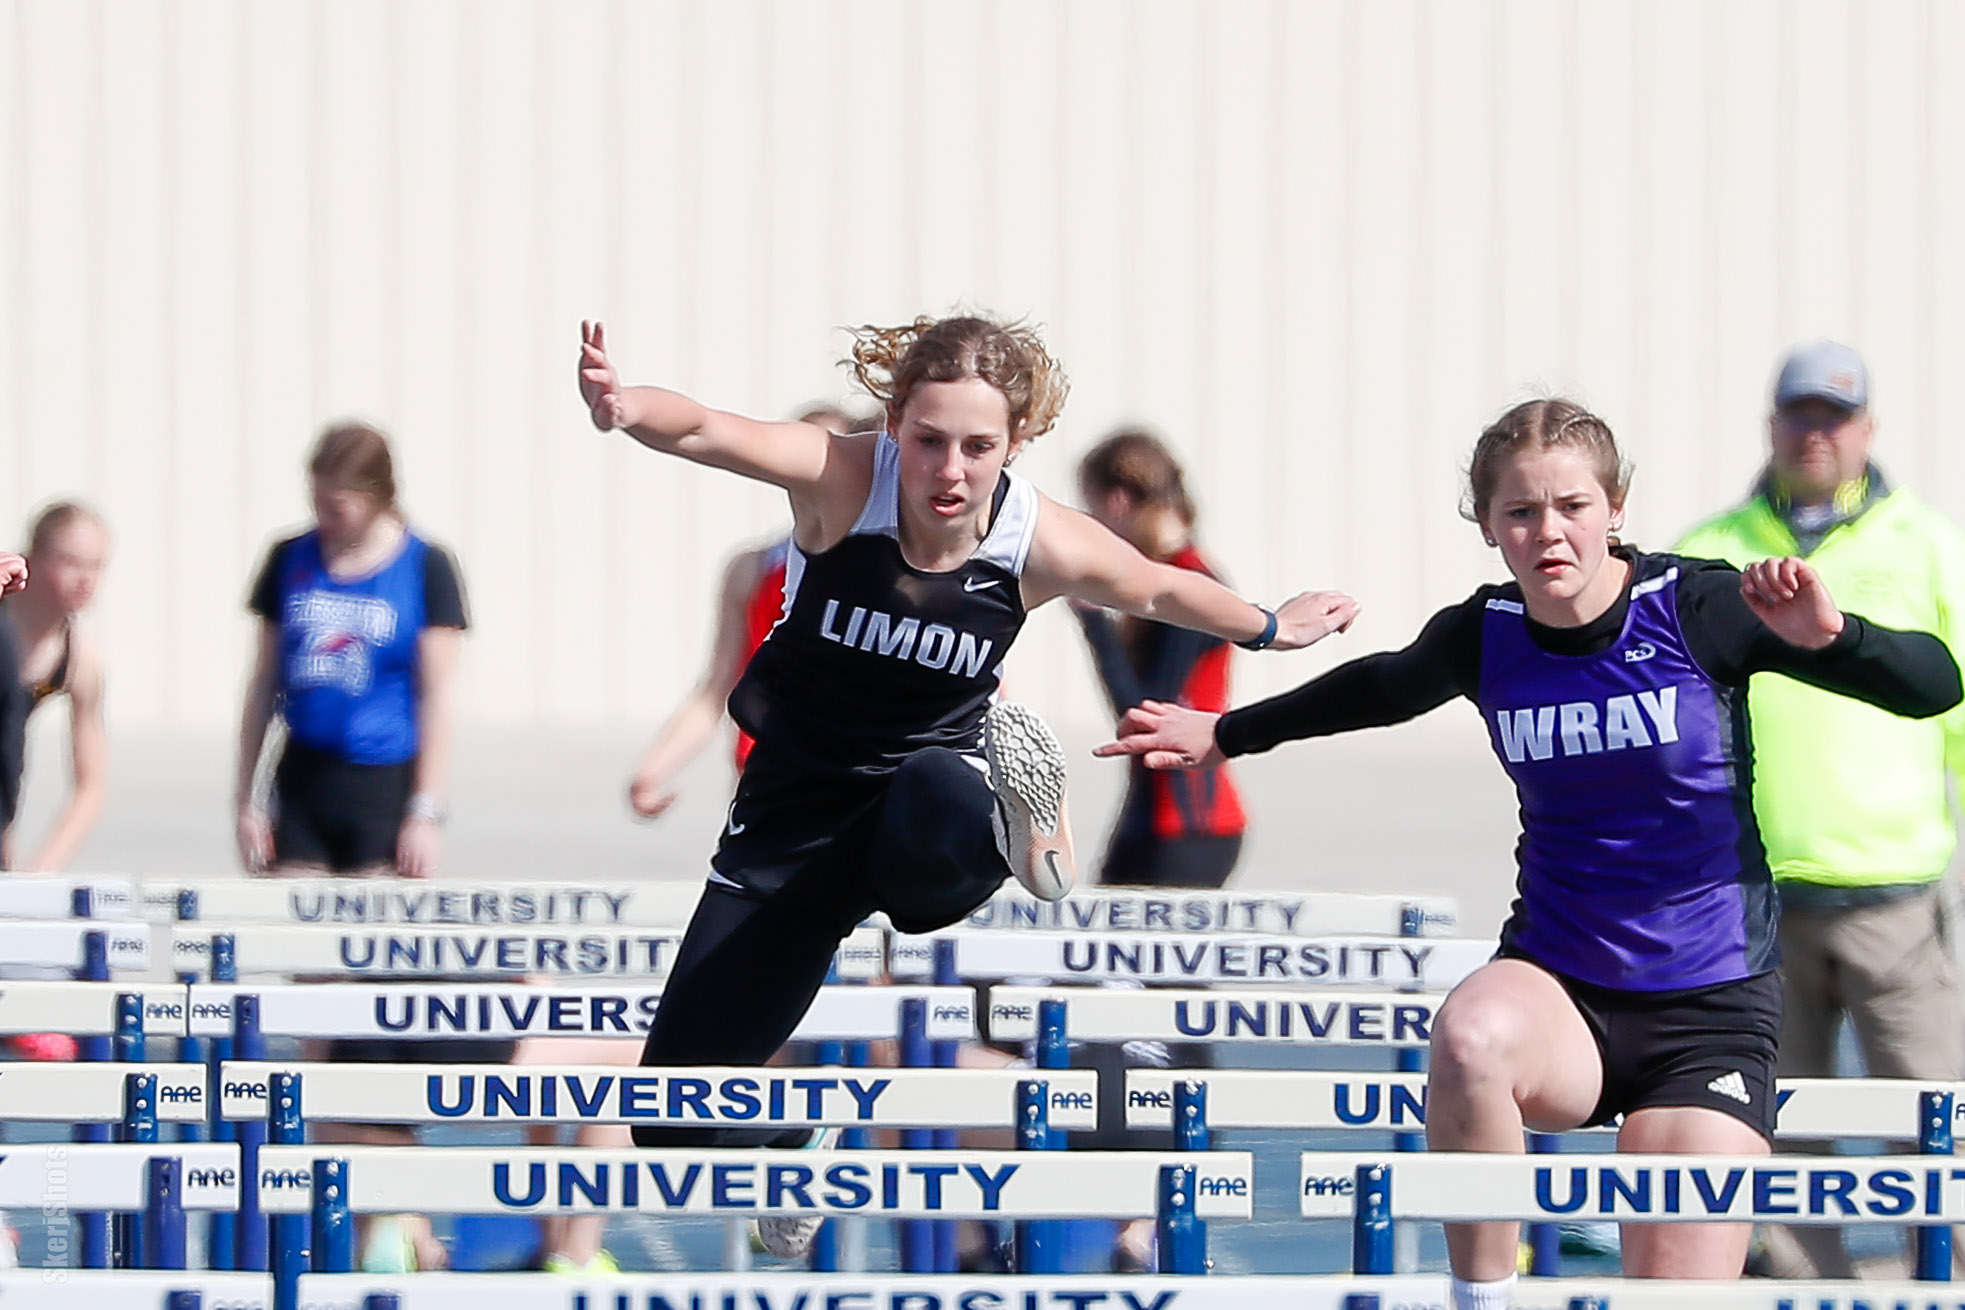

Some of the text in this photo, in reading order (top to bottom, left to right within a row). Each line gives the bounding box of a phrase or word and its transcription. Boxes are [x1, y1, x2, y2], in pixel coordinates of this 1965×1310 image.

[820, 599, 993, 679] LIMON
[1496, 685, 1679, 763] WRAY
[289, 889, 634, 922] UNIVERSITY
[968, 900, 1301, 931] UNIVERSITY
[340, 935, 683, 972] UNIVERSIT
[1063, 940, 1431, 979] UNIVERSITY
[376, 995, 662, 1033] UNIVERS
[1175, 1001, 1431, 1041] UNIVER
[427, 1074, 892, 1121] UNIVERSITY
[492, 1162, 1021, 1211] UNIVERSITY
[1535, 1166, 1965, 1217] UNIVERSI
